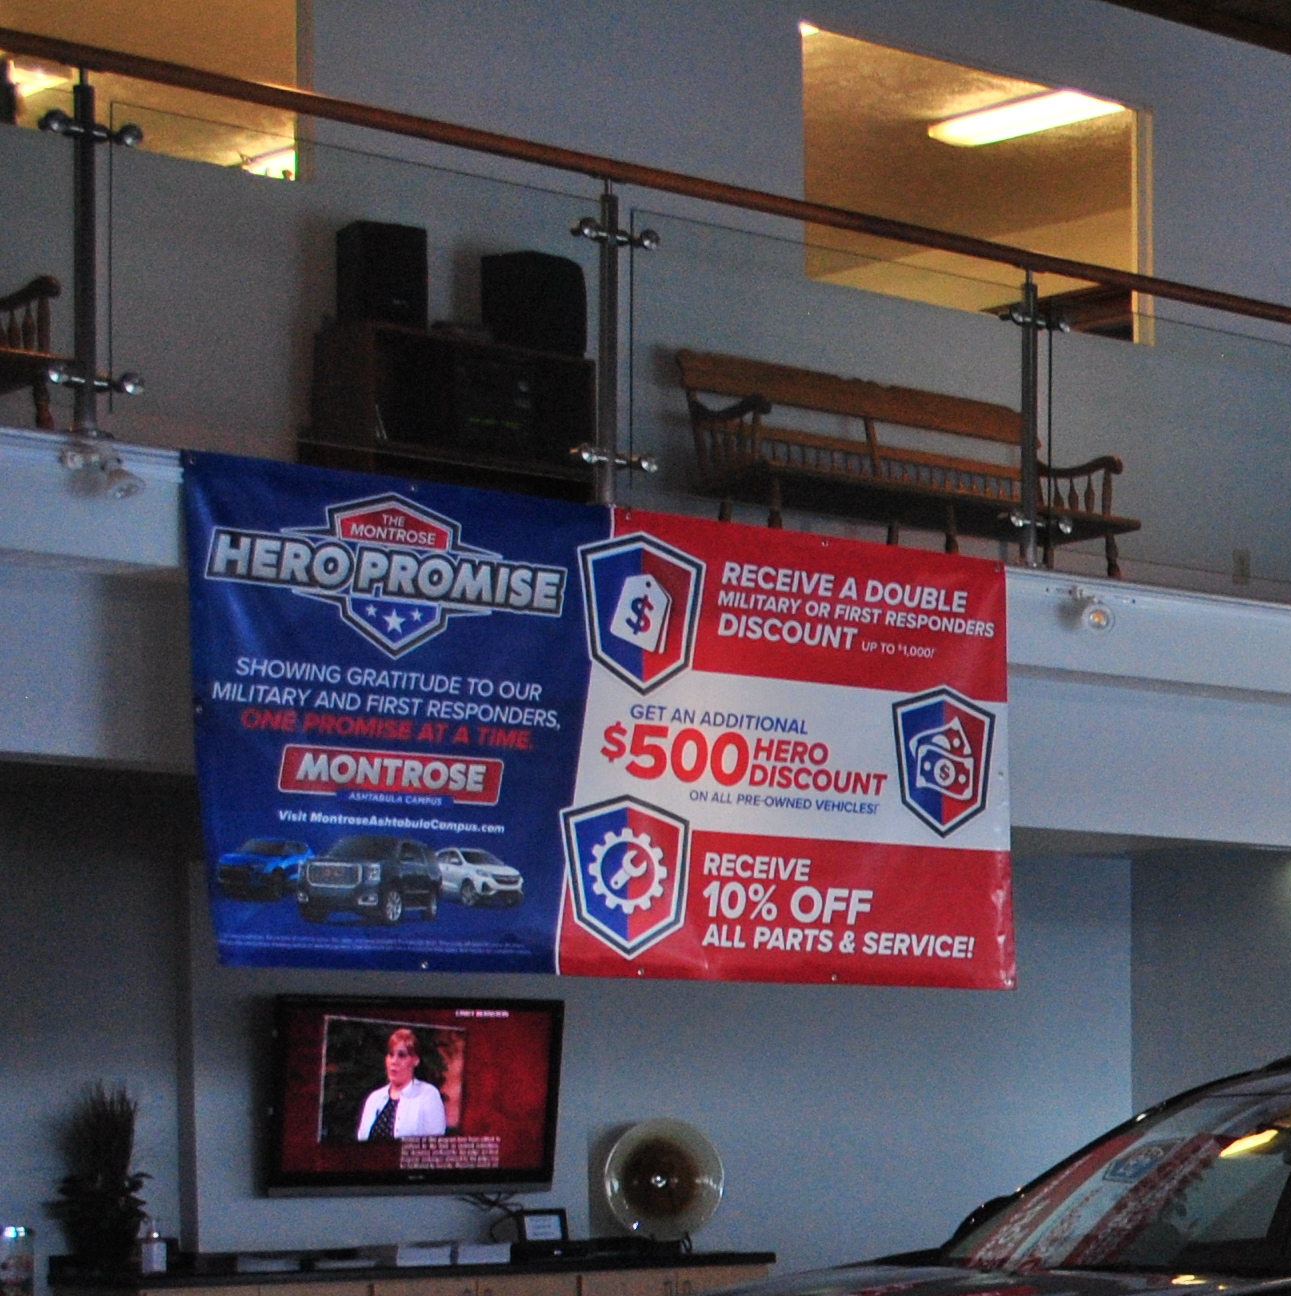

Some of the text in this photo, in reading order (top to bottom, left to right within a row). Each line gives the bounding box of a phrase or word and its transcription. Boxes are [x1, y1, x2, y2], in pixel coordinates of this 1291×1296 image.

[350, 523, 436, 546] MONTROSE
[382, 514, 405, 528] THE
[211, 532, 563, 610] HERO PROMISE
[722, 562, 968, 613] RECEIVE A DOUBLE
[717, 591, 995, 639] MILITARY OR FIRST RESPONDERS
[718, 614, 859, 651] DISCOUNT
[861, 641, 877, 652] UP
[881, 642, 895, 654] TO
[236, 656, 542, 701] SHOWING GRATITUDE TO OUR
[212, 680, 561, 730] MILITARY AND FIRST RESPONDERS,
[630, 704, 808, 736] GET AN ADDITIONAL
[241, 707, 535, 750] ONE PROMISE AT A TIME.
[296, 752, 487, 792] MONTROSE
[600, 721, 829, 787] $500 HERO
[349, 792, 442, 806] ASHTABULA CAMPUS
[749, 763, 887, 796] DISCOUNT
[689, 790, 708, 802] ON
[710, 792, 733, 805] ALL
[736, 794, 812, 810] PRE-OWNED
[278, 810, 504, 834] Visit MontroseAshtabulaCampus.com
[704, 852, 811, 882] RECEIVE
[703, 881, 873, 925] 10% OFF
[702, 924, 974, 960] ALL PARTS & SERVICE!
